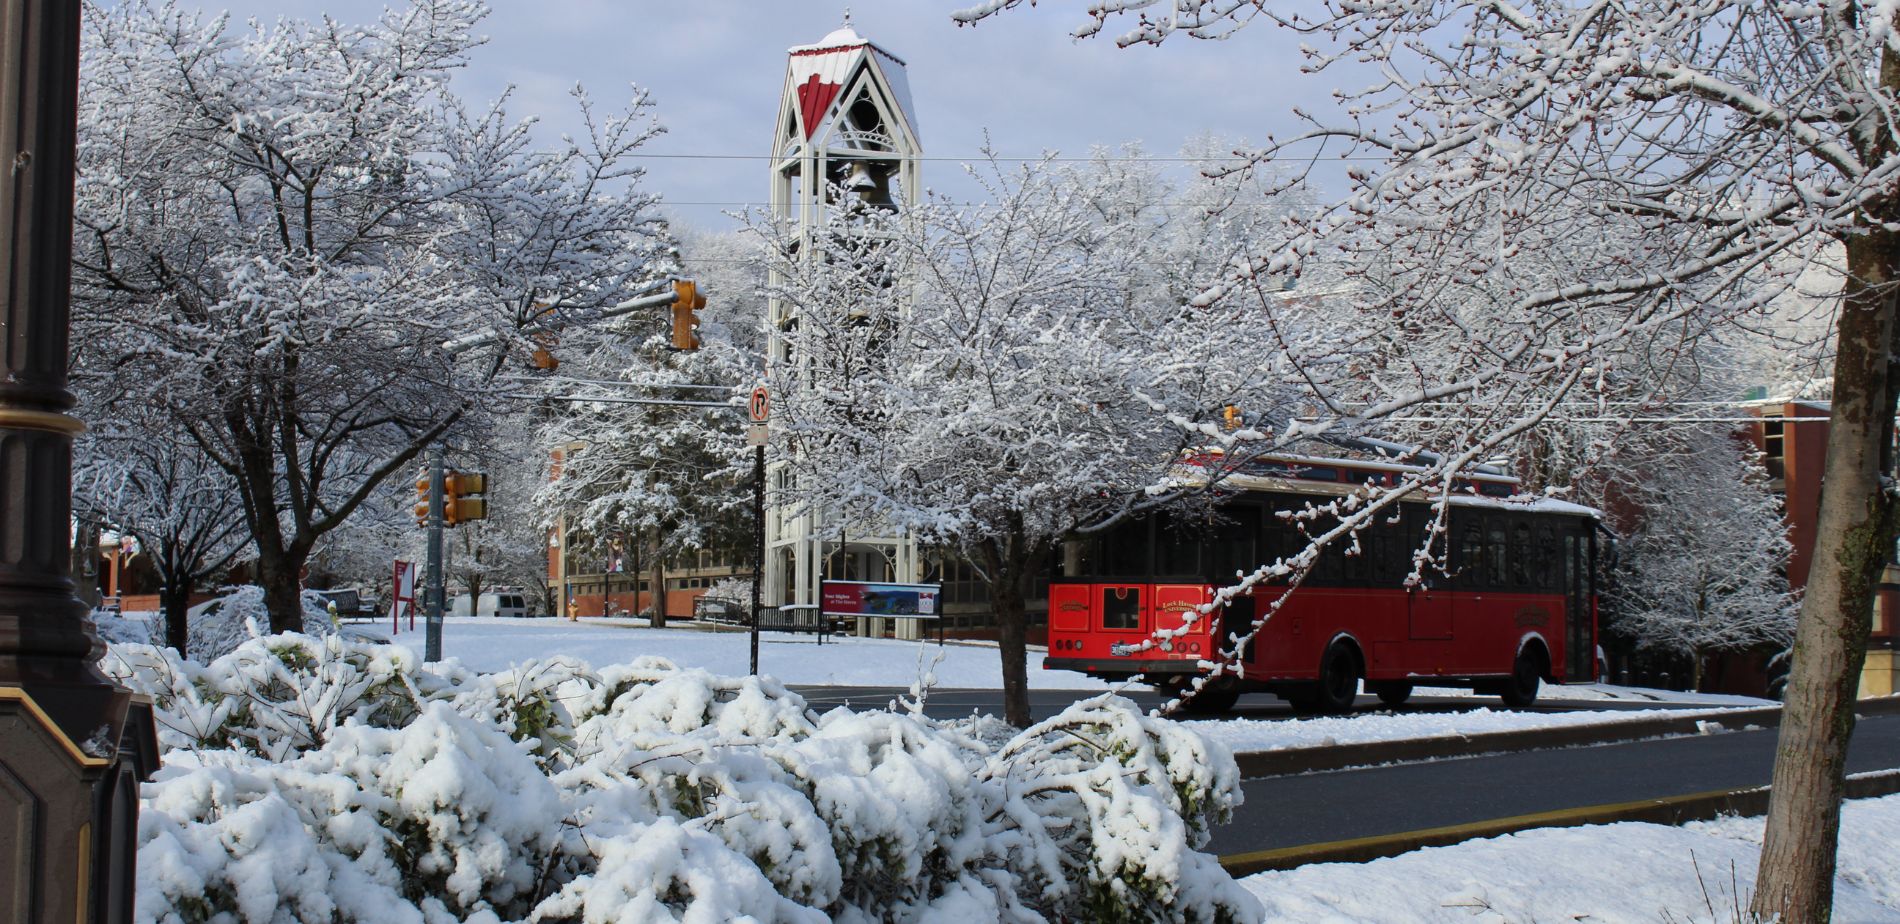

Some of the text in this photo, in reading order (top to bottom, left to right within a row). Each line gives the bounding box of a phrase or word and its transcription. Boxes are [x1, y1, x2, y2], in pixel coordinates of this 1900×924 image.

[756, 393, 766, 415] P
[1162, 600, 1196, 609] Lock Haven
